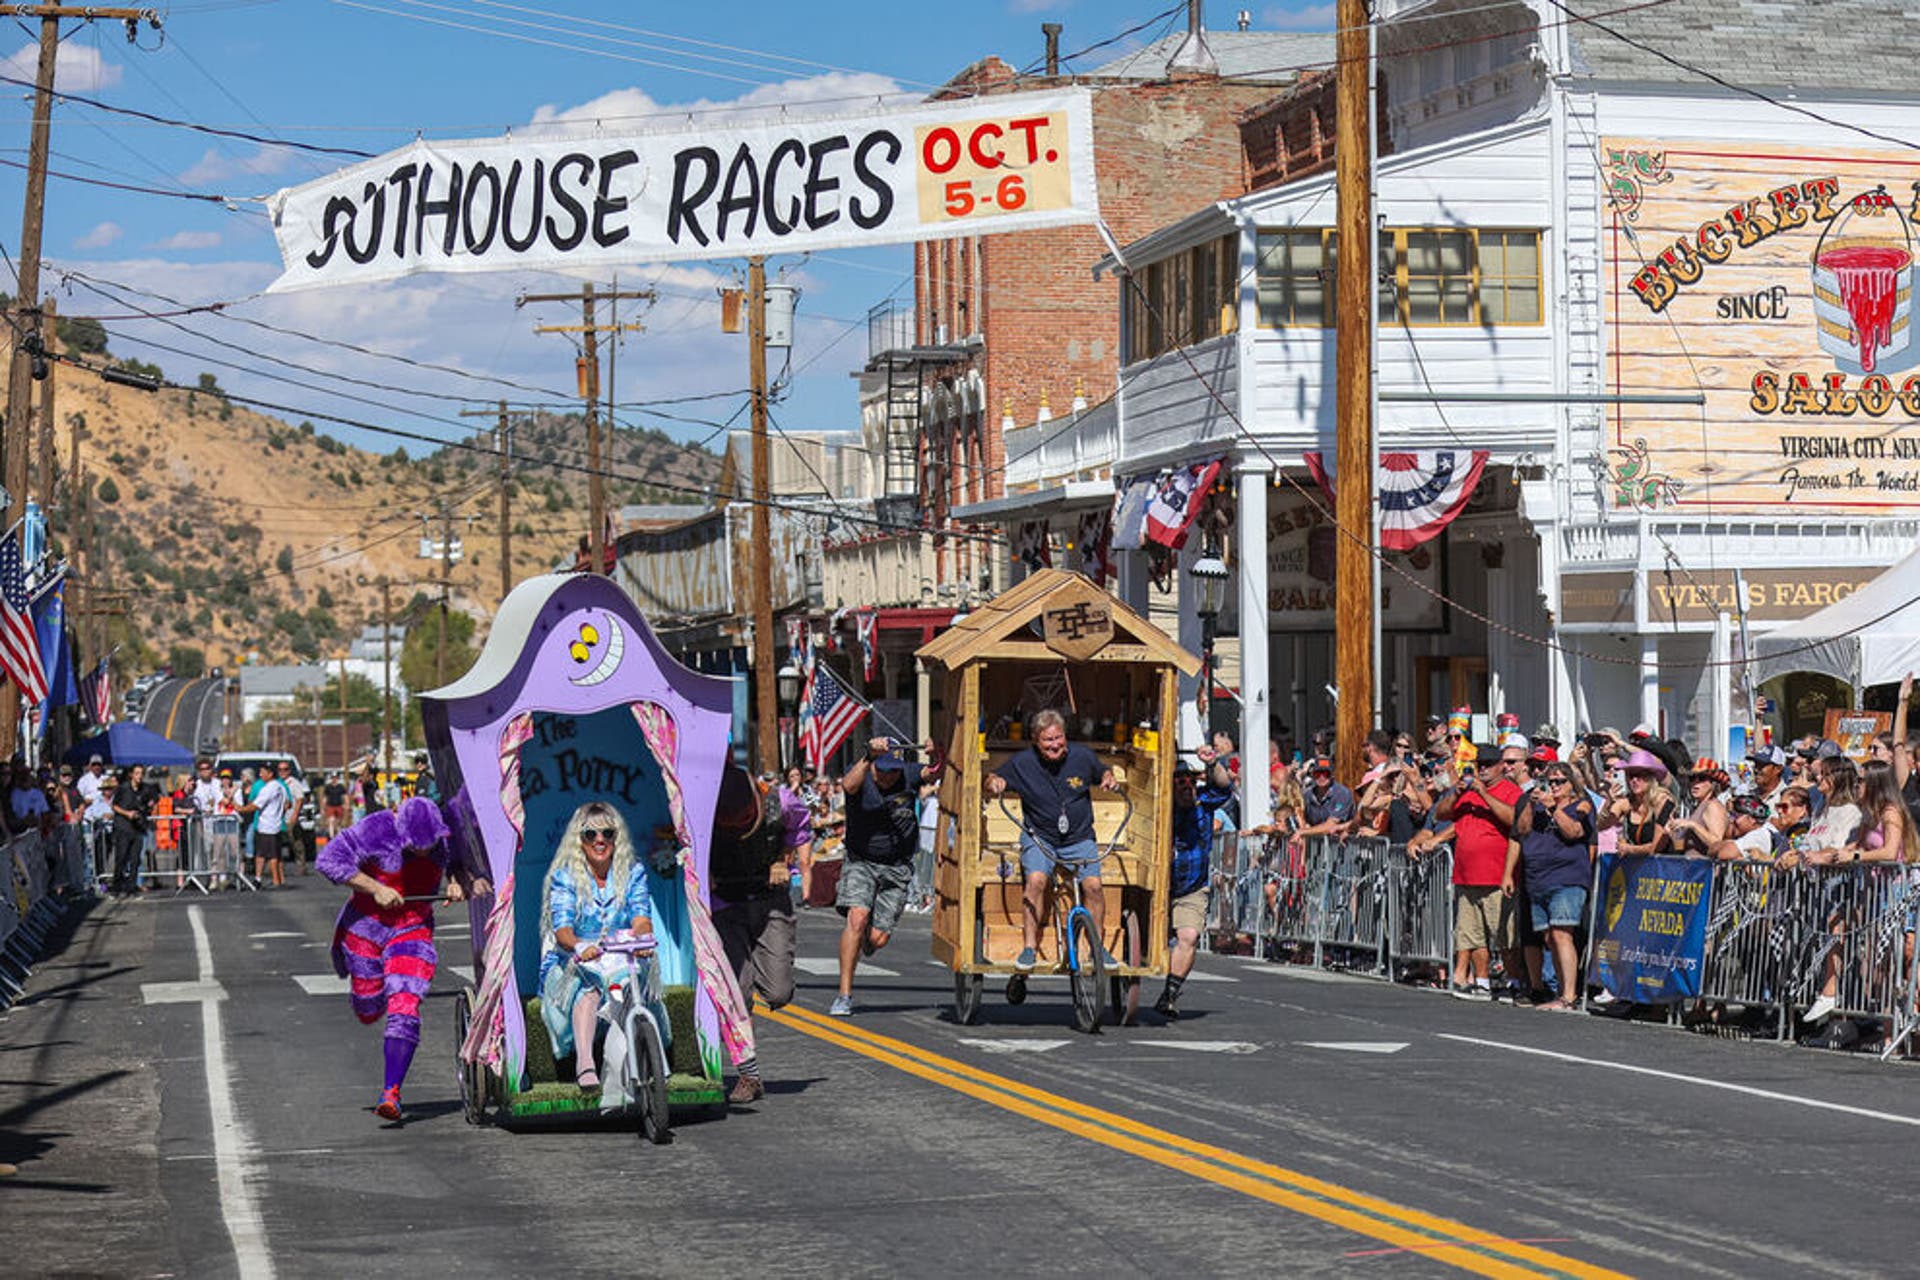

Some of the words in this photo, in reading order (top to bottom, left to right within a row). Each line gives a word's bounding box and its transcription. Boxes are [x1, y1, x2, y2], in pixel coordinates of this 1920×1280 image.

[922, 117, 1058, 174] OCT.
[667, 128, 903, 247] RACES
[945, 174, 1027, 216] 5-6
[1628, 176, 1840, 314] BUCKET
[1852, 194, 1894, 217] OF
[1716, 286, 1789, 320] SINCE
[1780, 436, 1849, 459] VIRGINIA
[1854, 437, 1888, 459] CITY
[1773, 581, 1872, 606] FARG
[535, 715, 577, 748] The
[1639, 909, 1684, 936] NEVADA
